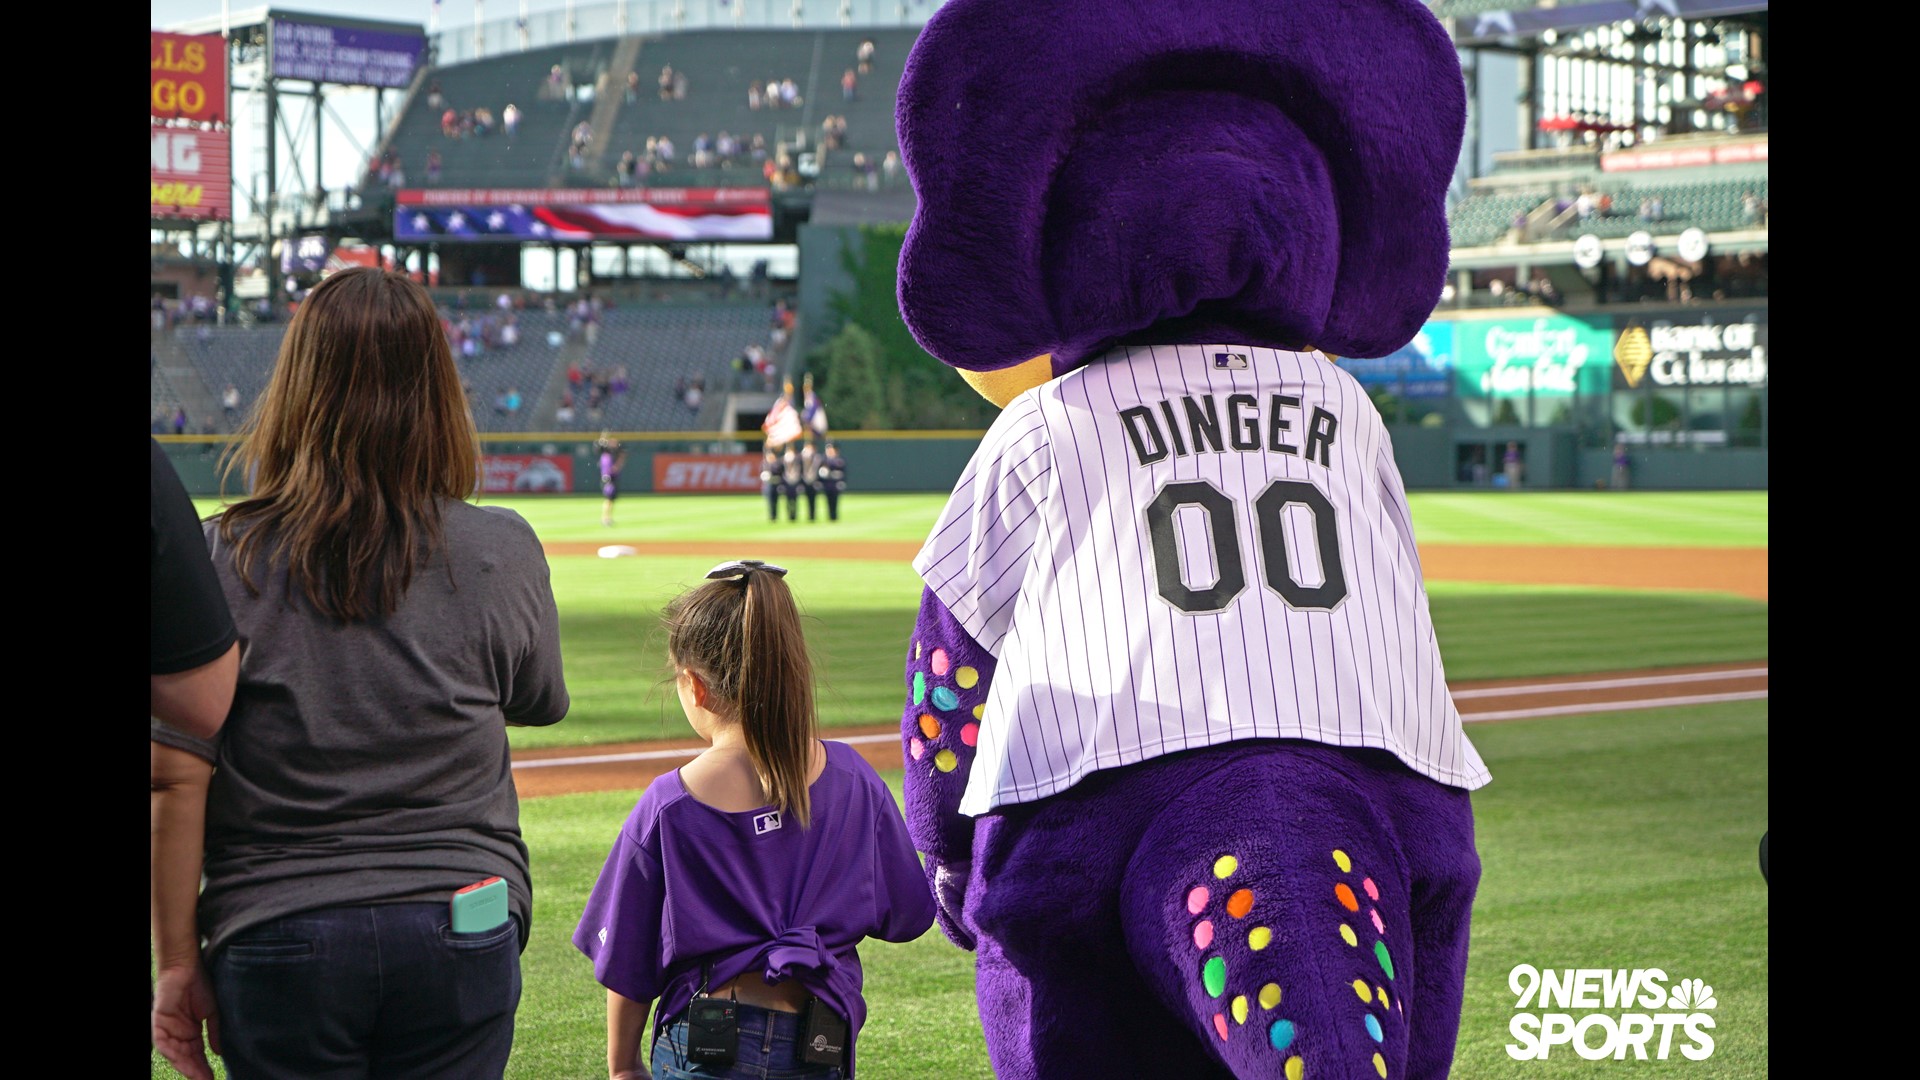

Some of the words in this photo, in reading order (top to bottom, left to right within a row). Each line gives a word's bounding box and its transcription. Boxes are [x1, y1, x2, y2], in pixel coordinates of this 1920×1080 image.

[153, 79, 205, 114] GO
[1651, 324, 1721, 351] Bank
[1651, 345, 1768, 385] Colorad
[1118, 393, 1338, 469] DINGER
[664, 461, 757, 488] STIHL
[1143, 476, 1351, 616] 00
